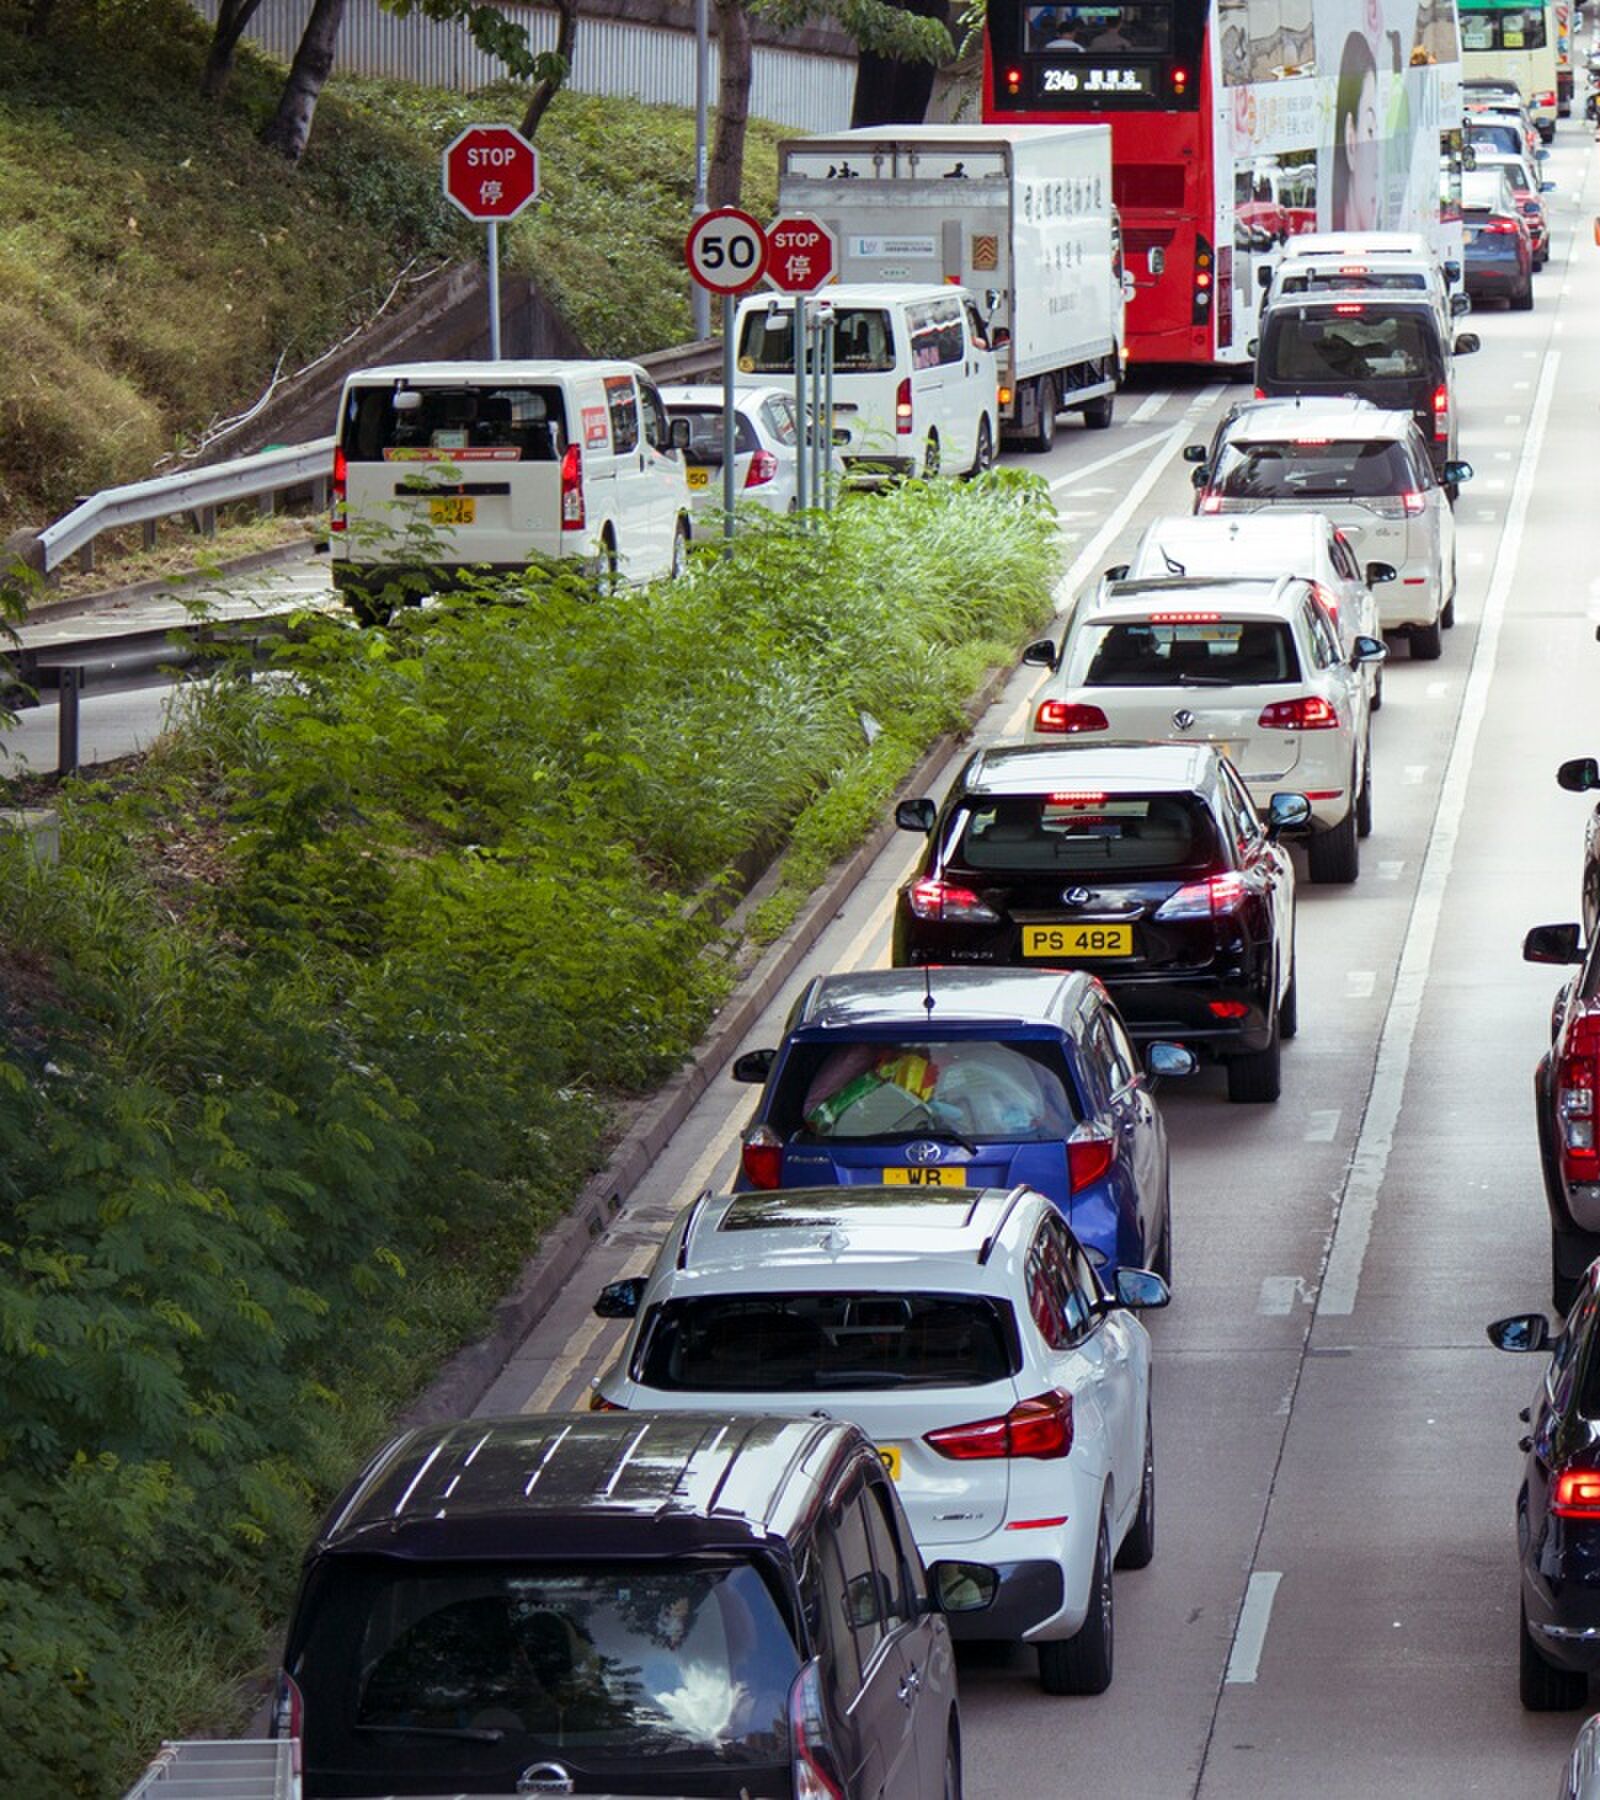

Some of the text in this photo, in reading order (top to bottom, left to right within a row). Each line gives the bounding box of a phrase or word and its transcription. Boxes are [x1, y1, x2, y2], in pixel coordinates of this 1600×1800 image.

[467, 147, 517, 167] STOP
[480, 180, 503, 205] 停
[775, 232, 820, 248] STOP
[701, 236, 755, 269] 50
[785, 254, 811, 281] 停
[1033, 932, 1121, 949] PS 482
